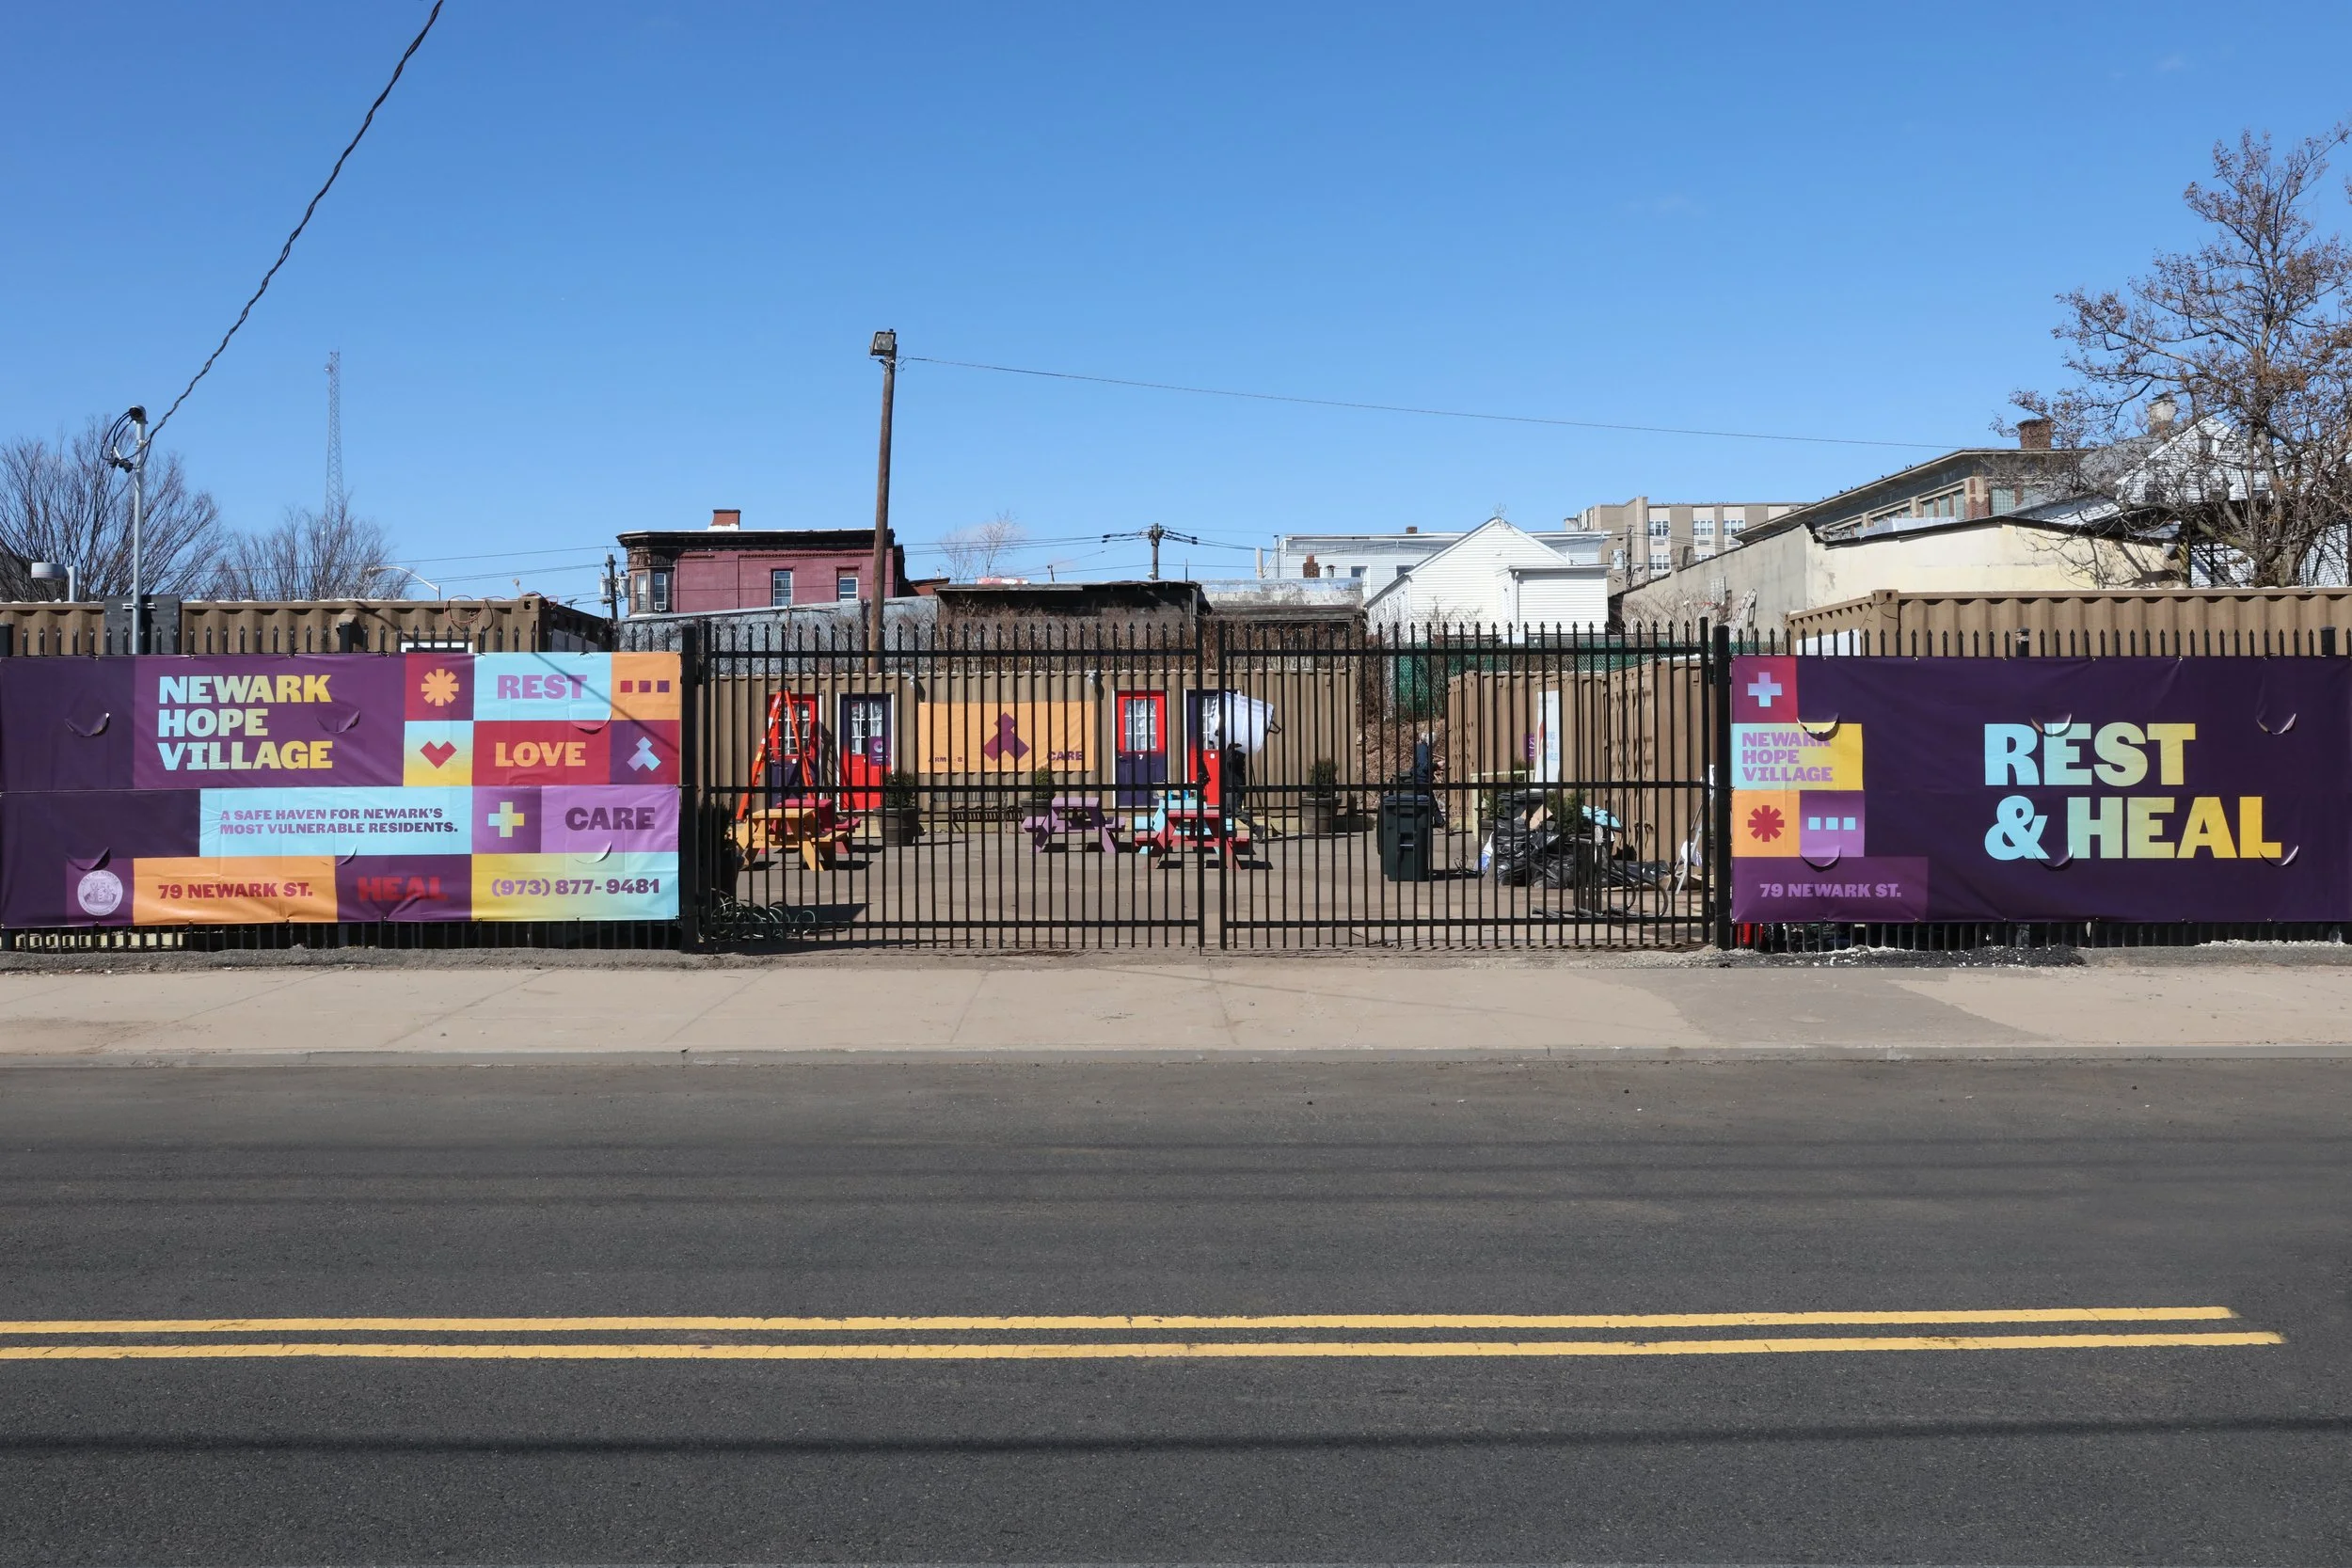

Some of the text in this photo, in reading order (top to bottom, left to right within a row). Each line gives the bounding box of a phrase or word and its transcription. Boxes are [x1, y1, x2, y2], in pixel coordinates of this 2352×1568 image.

[158, 674, 332, 704] NEWARK
[497, 674, 587, 699] REST
[158, 708, 268, 737] HOPE
[157, 741, 333, 770] VILLAGE
[495, 741, 585, 767] LOVE
[1047, 751, 1084, 761] CARE
[1742, 750, 1799, 764] HOPE
[1984, 721, 2196, 786] REST
[1742, 767, 1833, 782] VILLAGE
[220, 810, 230, 820] A
[234, 810, 272, 820] SAFE
[276, 809, 326, 820] HAVEN
[330, 809, 359, 819] FOR
[564, 807, 656, 831] CARE
[220, 822, 458, 835] MOST VULNERABLE RESIDENTS.
[1984, 795, 2281, 861] & HEAL
[158, 882, 312, 899] 79 NEWARK ST.
[357, 877, 448, 901] HEAL
[491, 879, 550, 897] (973)
[1759, 883, 1901, 897] 79 NEWARK ST.
